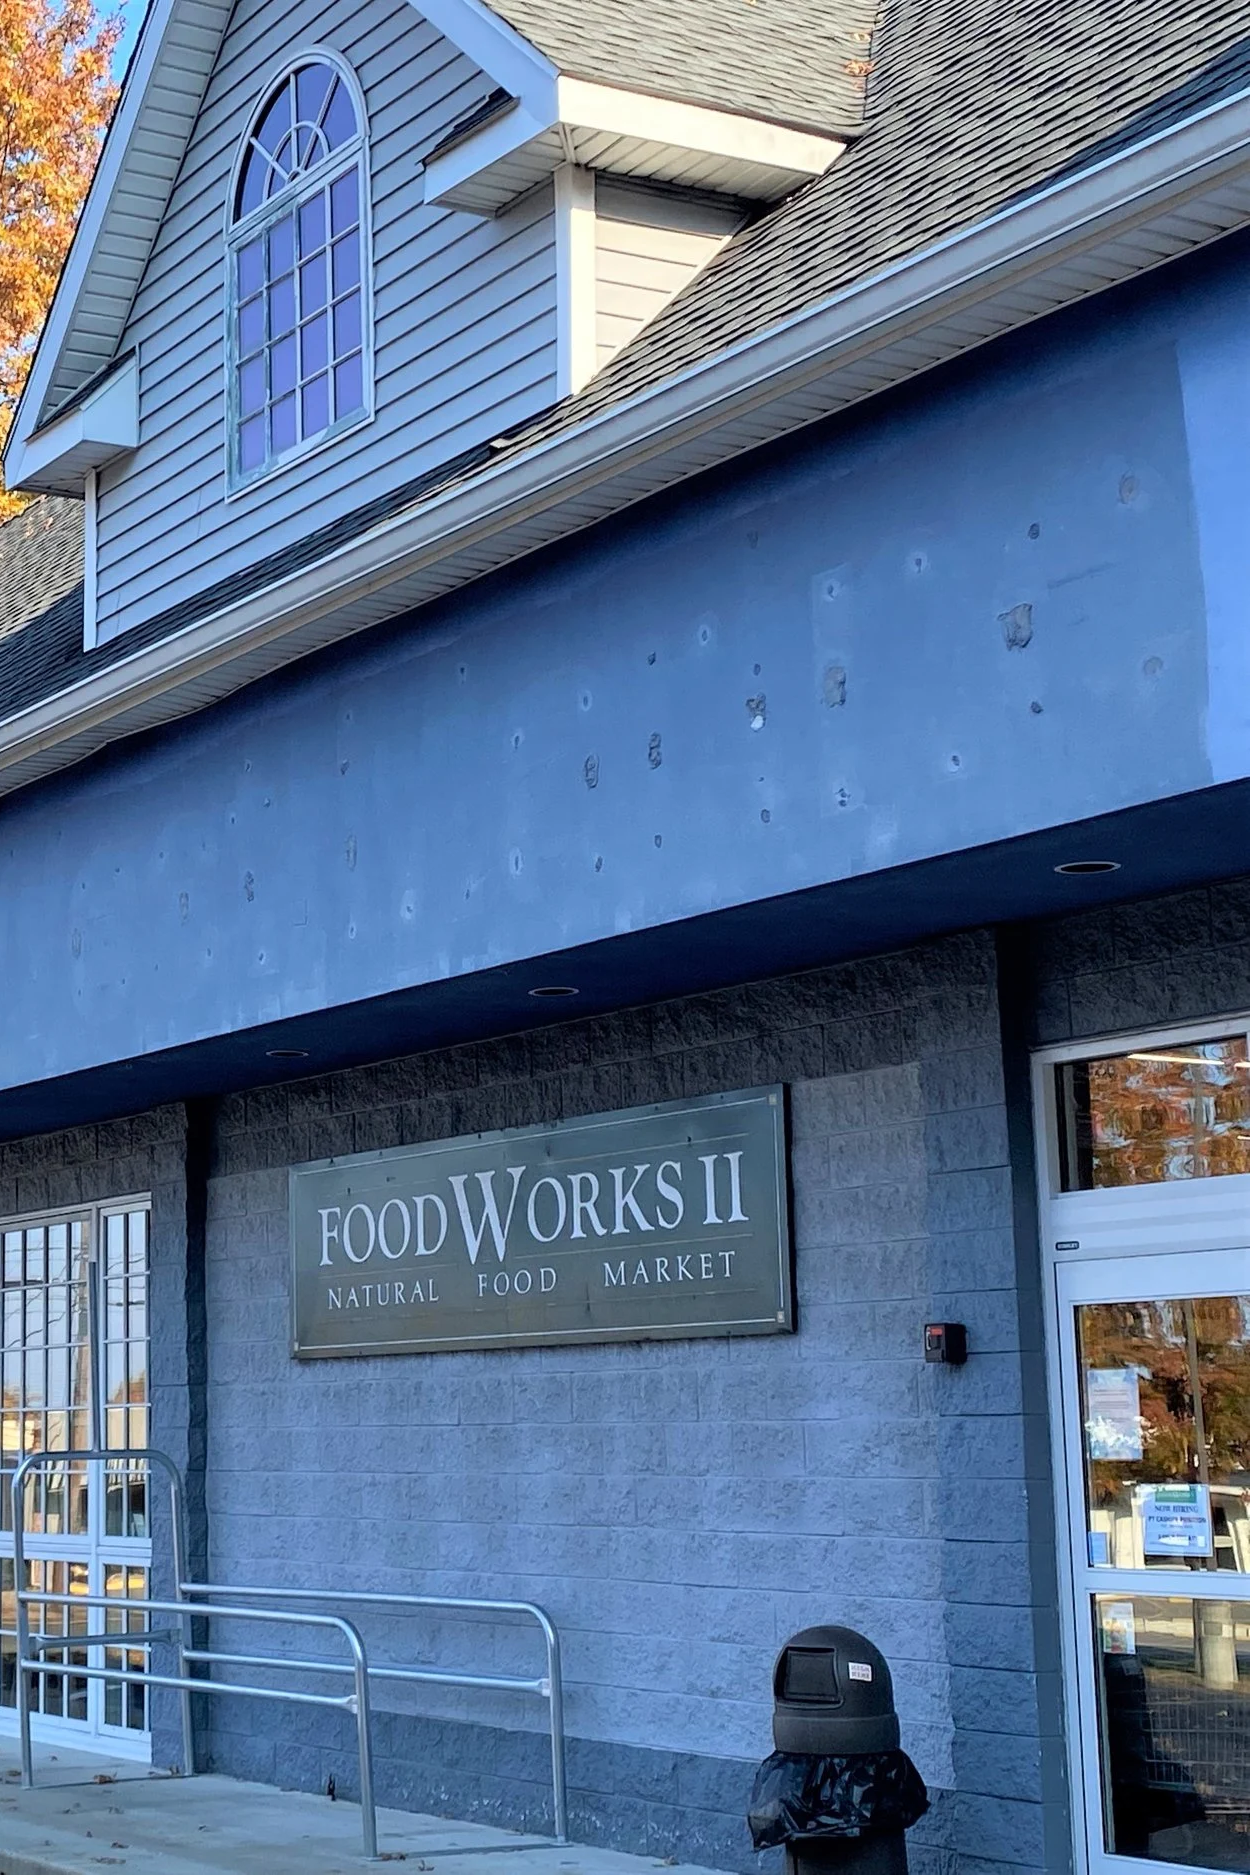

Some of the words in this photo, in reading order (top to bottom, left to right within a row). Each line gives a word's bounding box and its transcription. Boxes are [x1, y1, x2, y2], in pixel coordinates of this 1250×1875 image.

[697, 1151, 750, 1225] II
[327, 1278, 440, 1310] NATURAL
[477, 1268, 557, 1298] FOOD
[603, 1250, 736, 1288] MARKET
